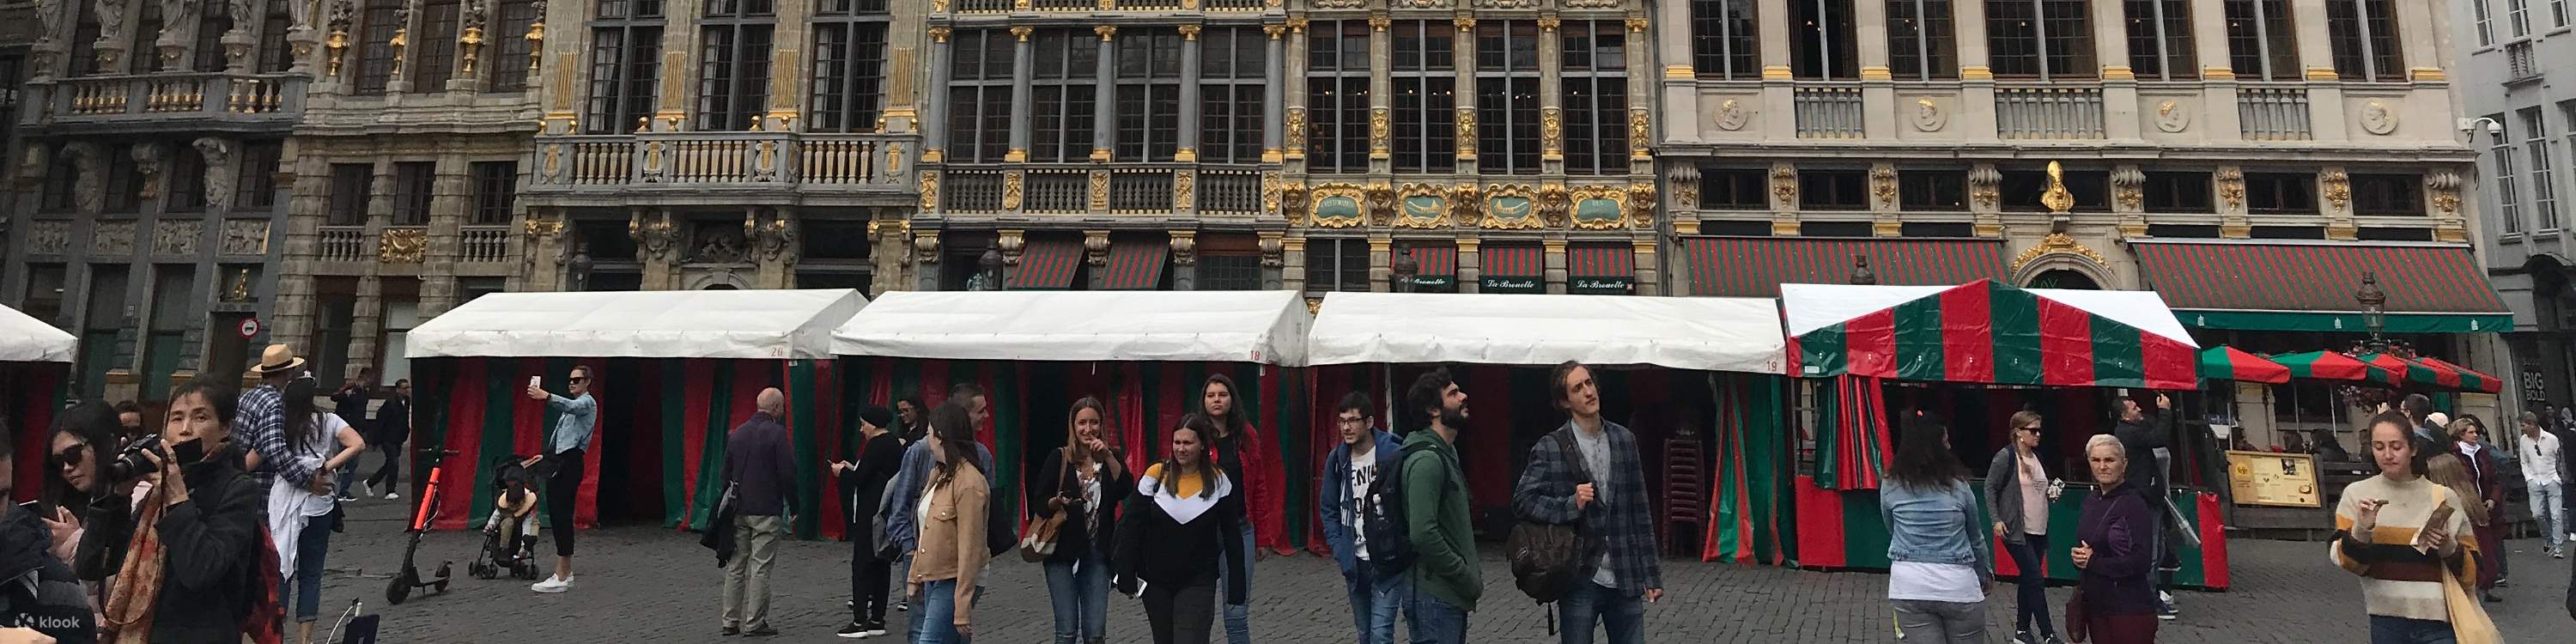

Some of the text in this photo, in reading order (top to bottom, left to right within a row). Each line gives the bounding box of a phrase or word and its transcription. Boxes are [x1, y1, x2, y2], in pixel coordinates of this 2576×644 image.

[1486, 279, 1498, 288] La
[1577, 280, 1589, 289] La
[1250, 350, 1261, 361] 18
[1766, 361, 1777, 372] 19
[2523, 371, 2544, 390] BIG
[2525, 390, 2546, 401] BOLD
